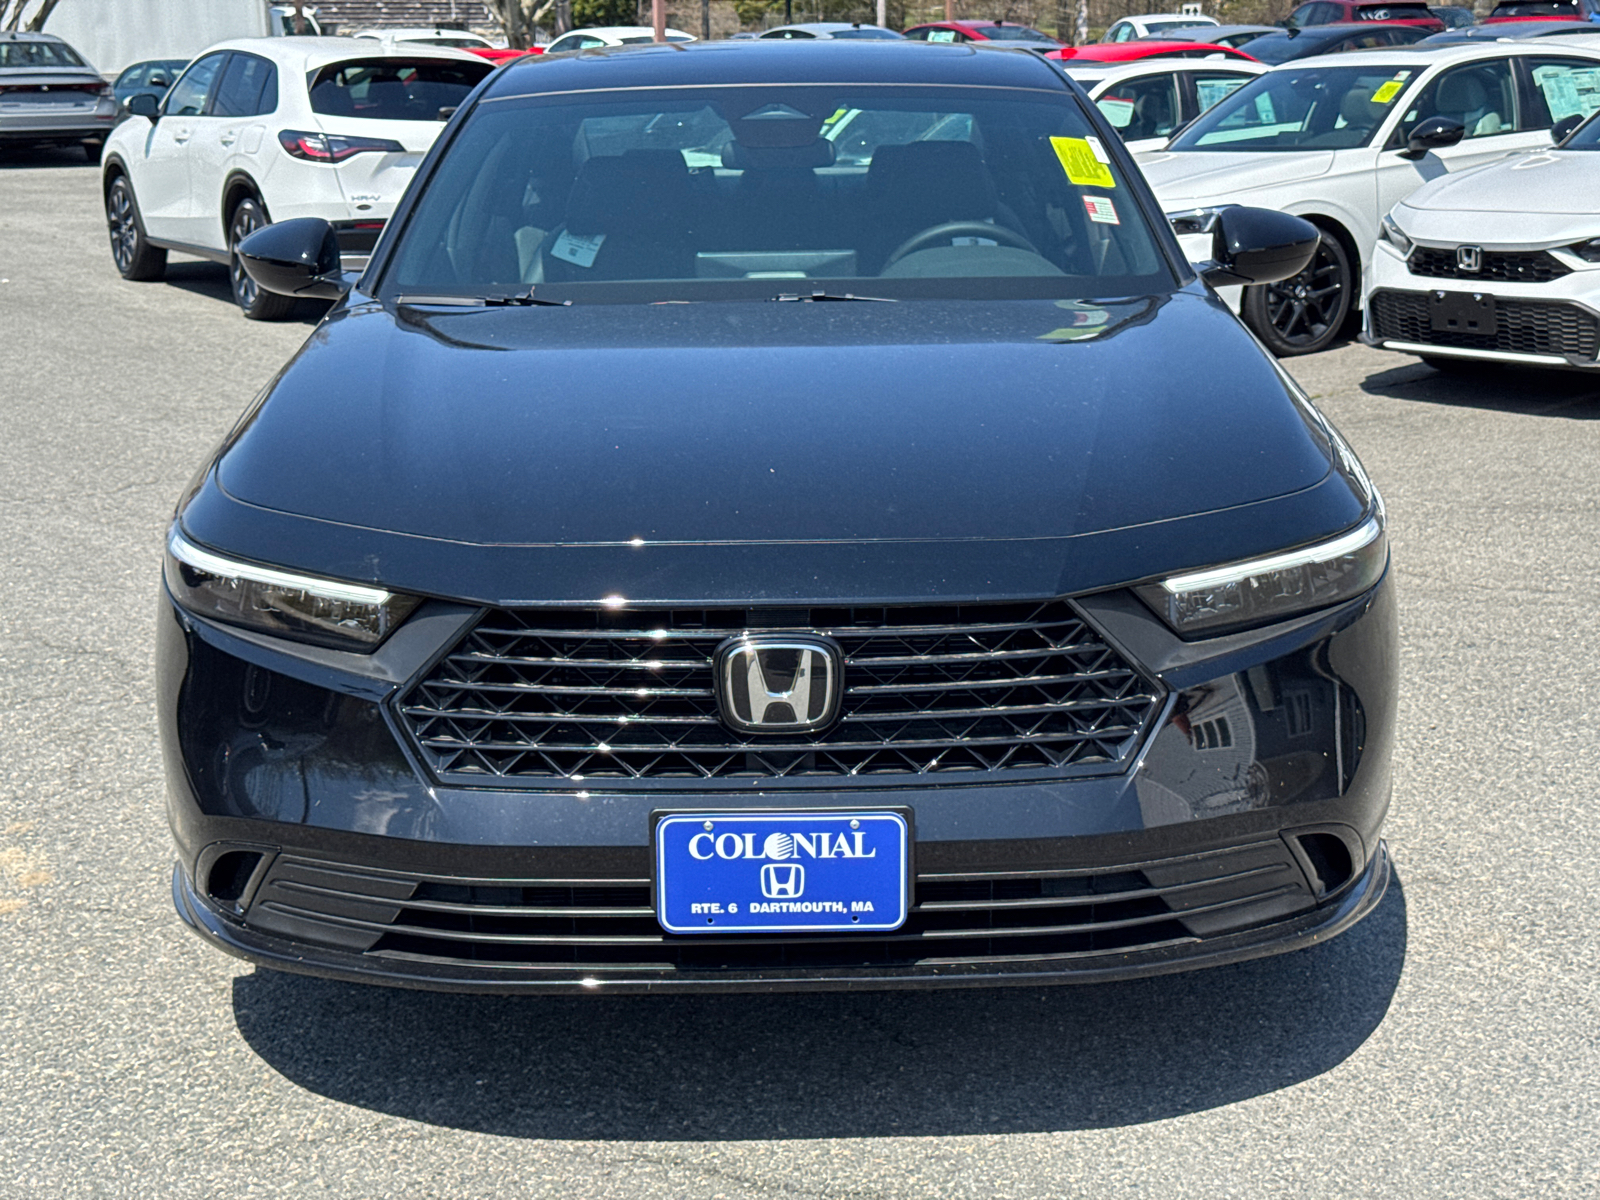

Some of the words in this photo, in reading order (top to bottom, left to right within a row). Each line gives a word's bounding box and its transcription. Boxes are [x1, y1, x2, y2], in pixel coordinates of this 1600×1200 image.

[688, 832, 877, 861] COLONIAL
[691, 902, 725, 914] RTE.
[727, 902, 738, 914] 6
[749, 901, 848, 914] DARTMOUTH,
[851, 901, 875, 912] MA
